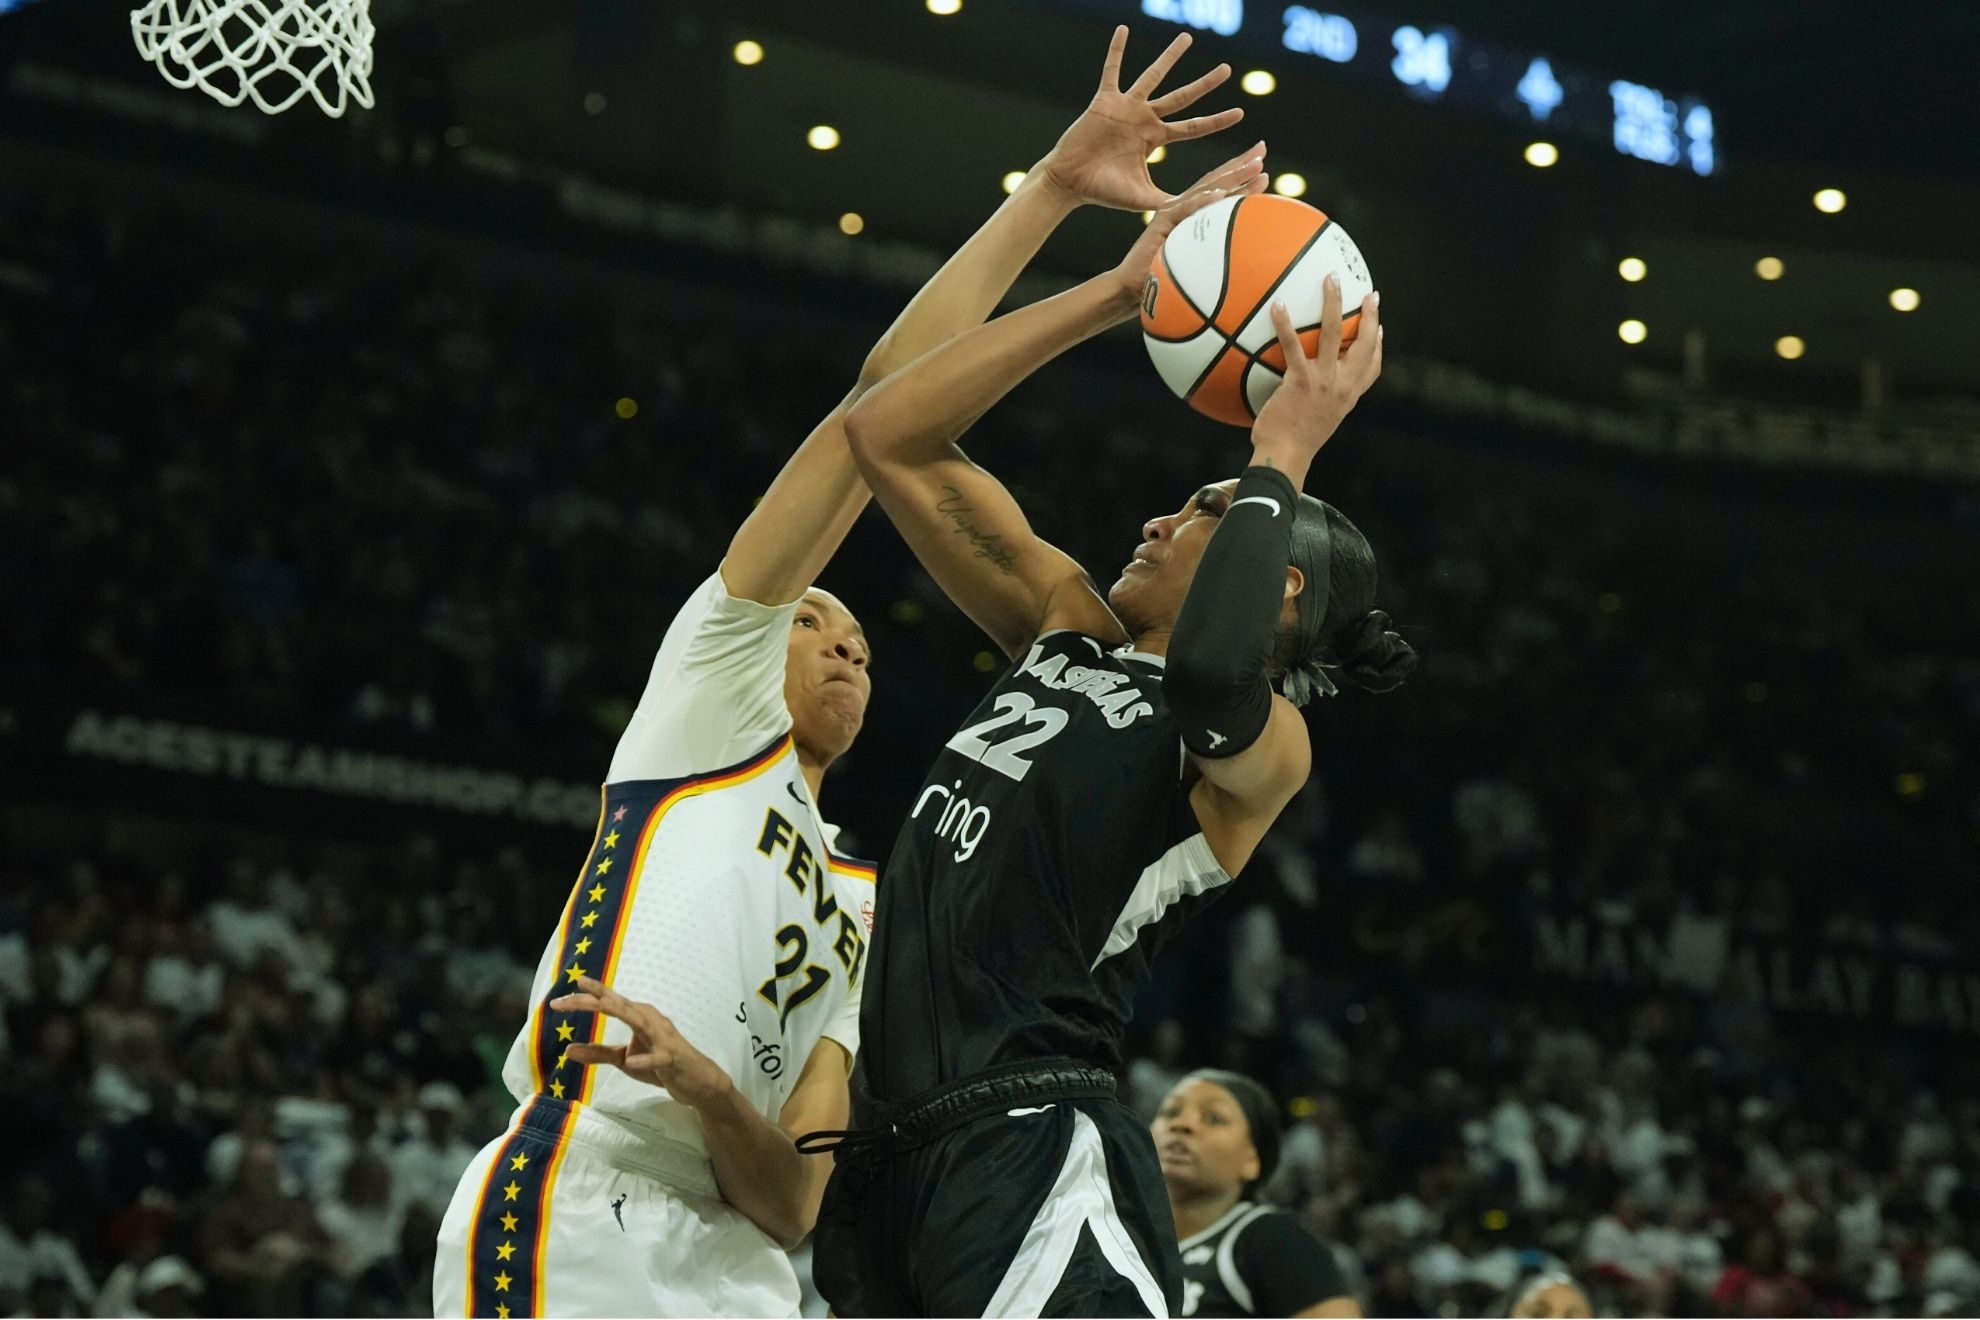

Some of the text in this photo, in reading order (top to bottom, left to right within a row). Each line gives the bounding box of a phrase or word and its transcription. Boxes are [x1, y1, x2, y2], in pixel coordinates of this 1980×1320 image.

[945, 691, 1069, 782] 22
[911, 780, 990, 863] ring
[756, 922, 831, 1036] 21
